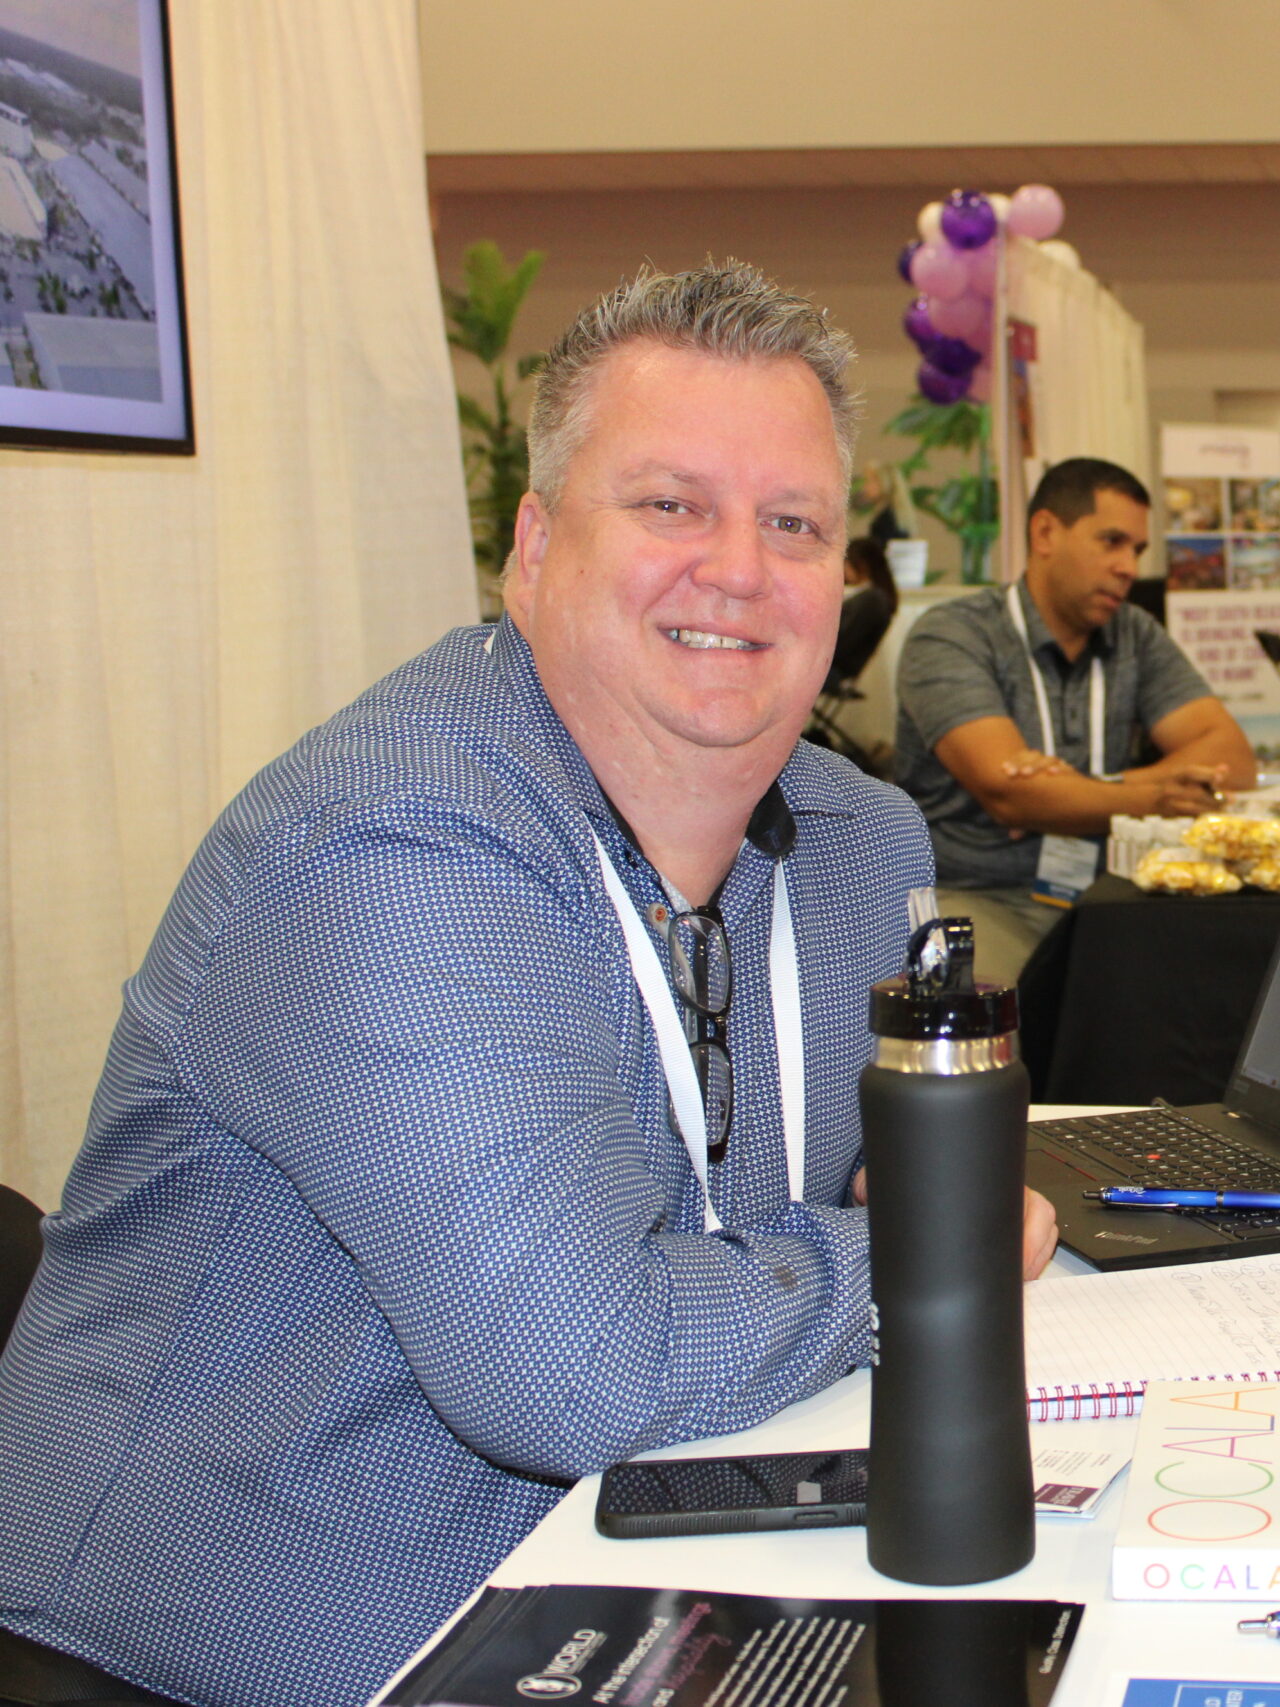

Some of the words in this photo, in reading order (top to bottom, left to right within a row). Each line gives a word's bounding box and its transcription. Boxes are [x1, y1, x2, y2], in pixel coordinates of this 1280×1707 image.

[1147, 1387, 1277, 1541] OCALA
[543, 1628, 598, 1674] WORLD
[611, 1628, 664, 1676] intersection
